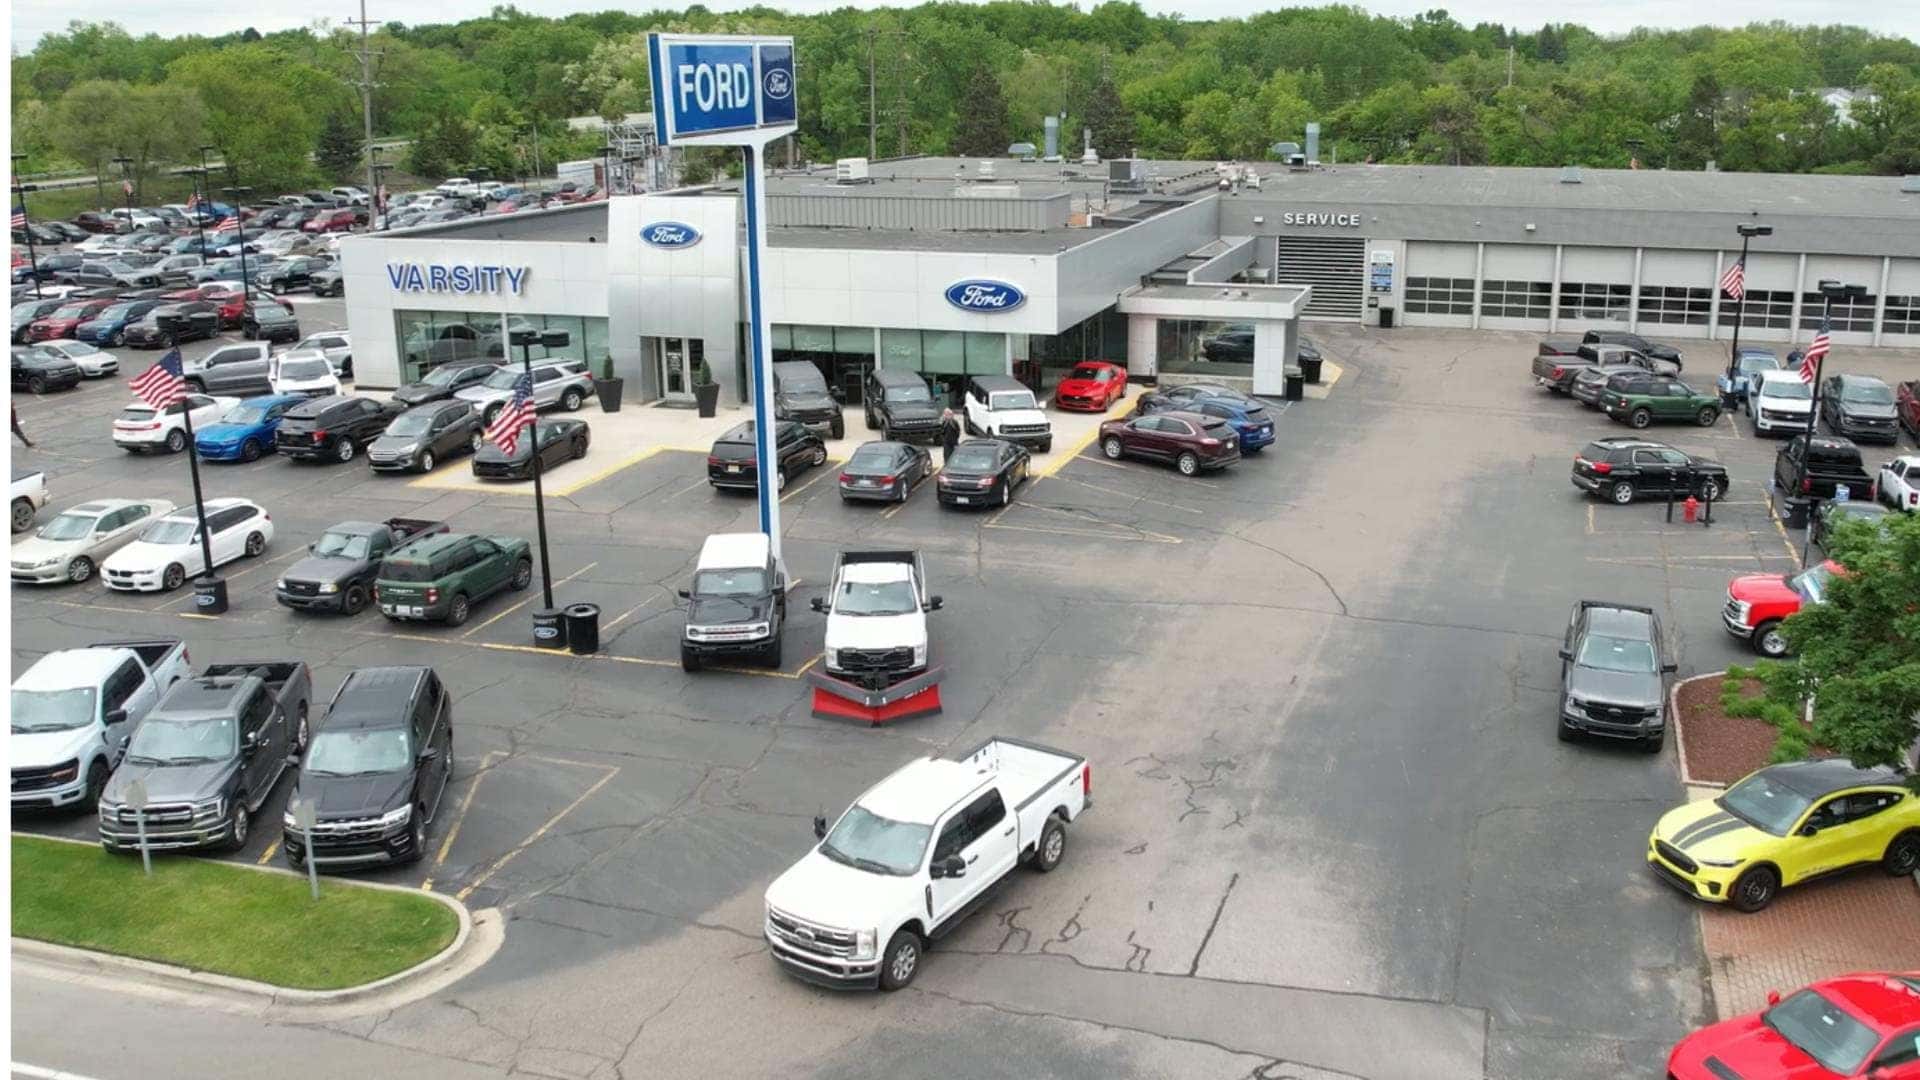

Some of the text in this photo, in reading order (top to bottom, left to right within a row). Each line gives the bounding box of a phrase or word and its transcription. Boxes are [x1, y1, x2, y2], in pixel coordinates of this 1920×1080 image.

[678, 62, 750, 113] FORD
[1283, 212, 1360, 226] SERVICE
[652, 226, 686, 242] Ford
[386, 263, 523, 294] VARSITY
[961, 285, 1007, 306] Ford
